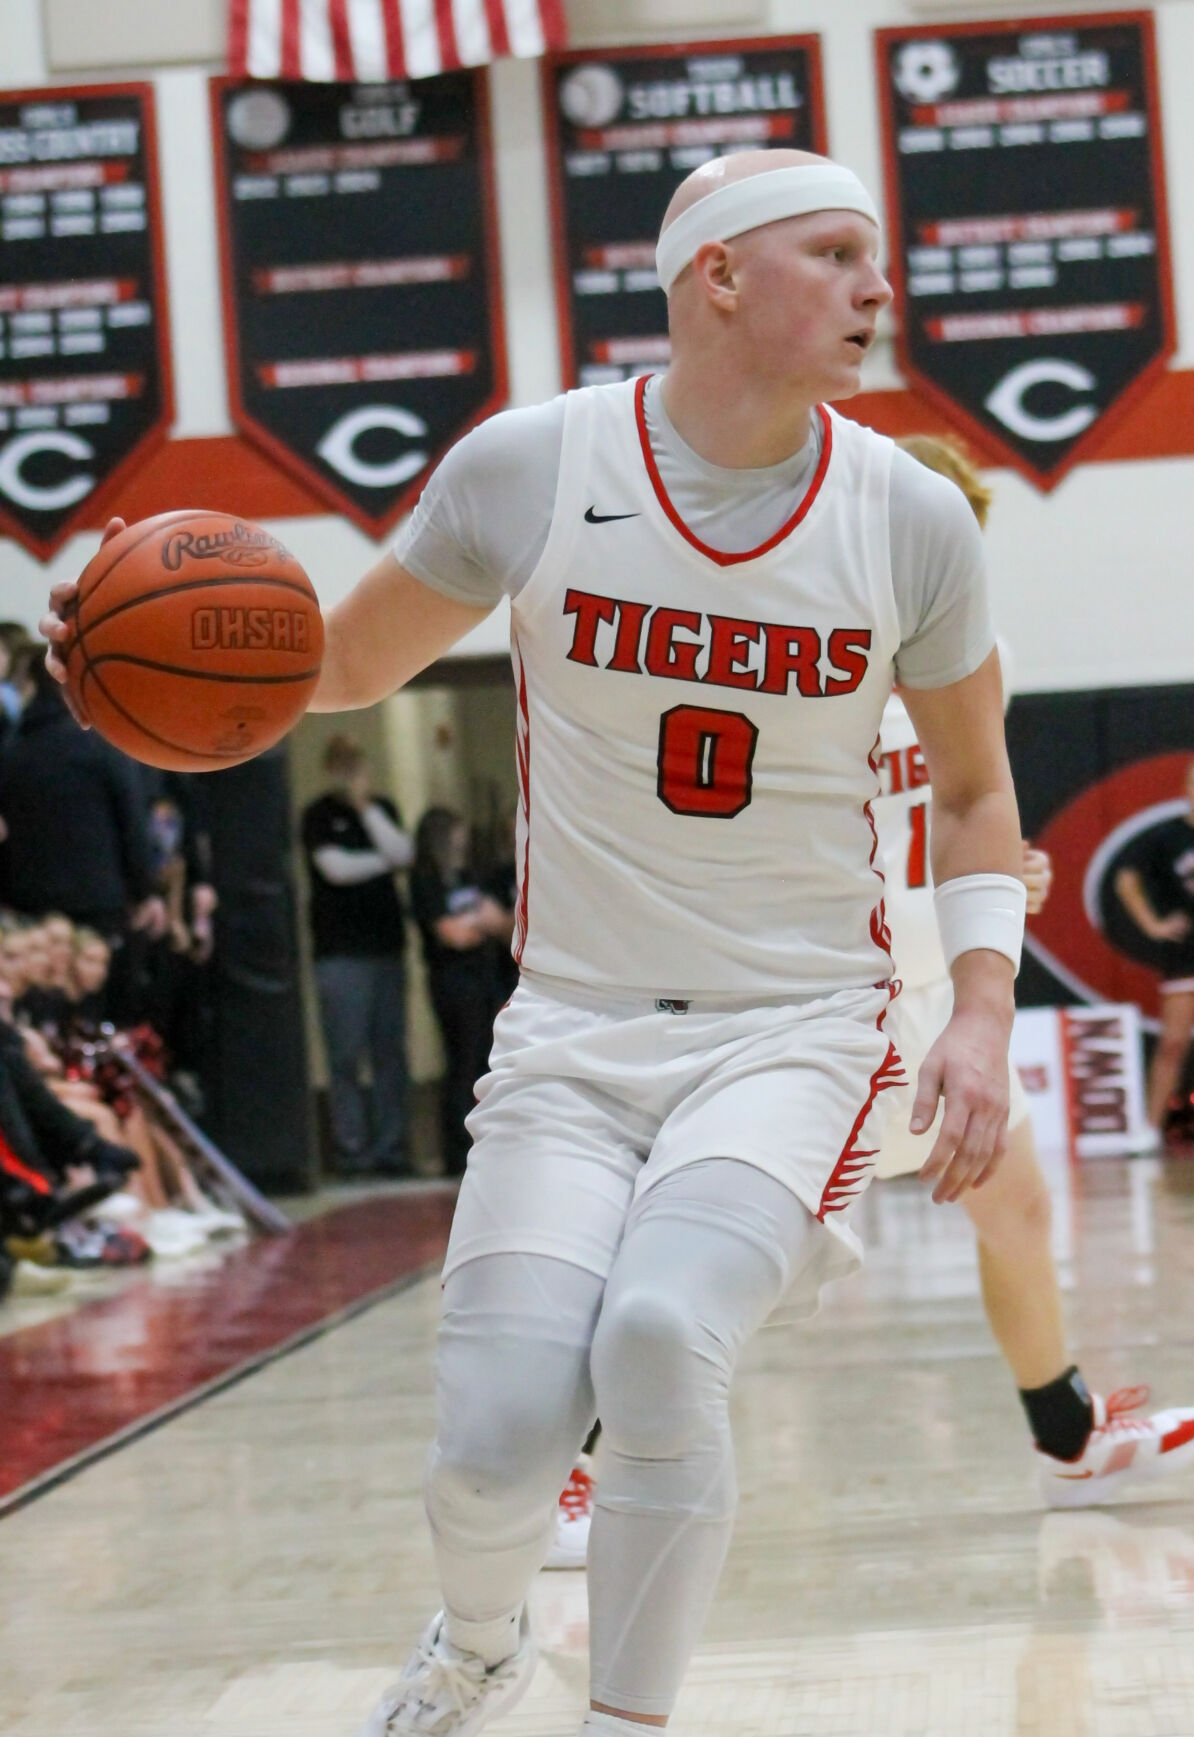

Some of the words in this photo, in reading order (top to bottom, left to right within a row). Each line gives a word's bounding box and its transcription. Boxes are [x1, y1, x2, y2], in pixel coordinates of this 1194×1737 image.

[630, 73, 802, 119] SOFTBALL
[987, 53, 1108, 94] SOCCER
[339, 102, 420, 139] GOLF
[984, 357, 1097, 442] C
[0, 430, 95, 511] C
[316, 403, 430, 488] C
[562, 588, 872, 697] TIGERS
[657, 704, 759, 819] 0
